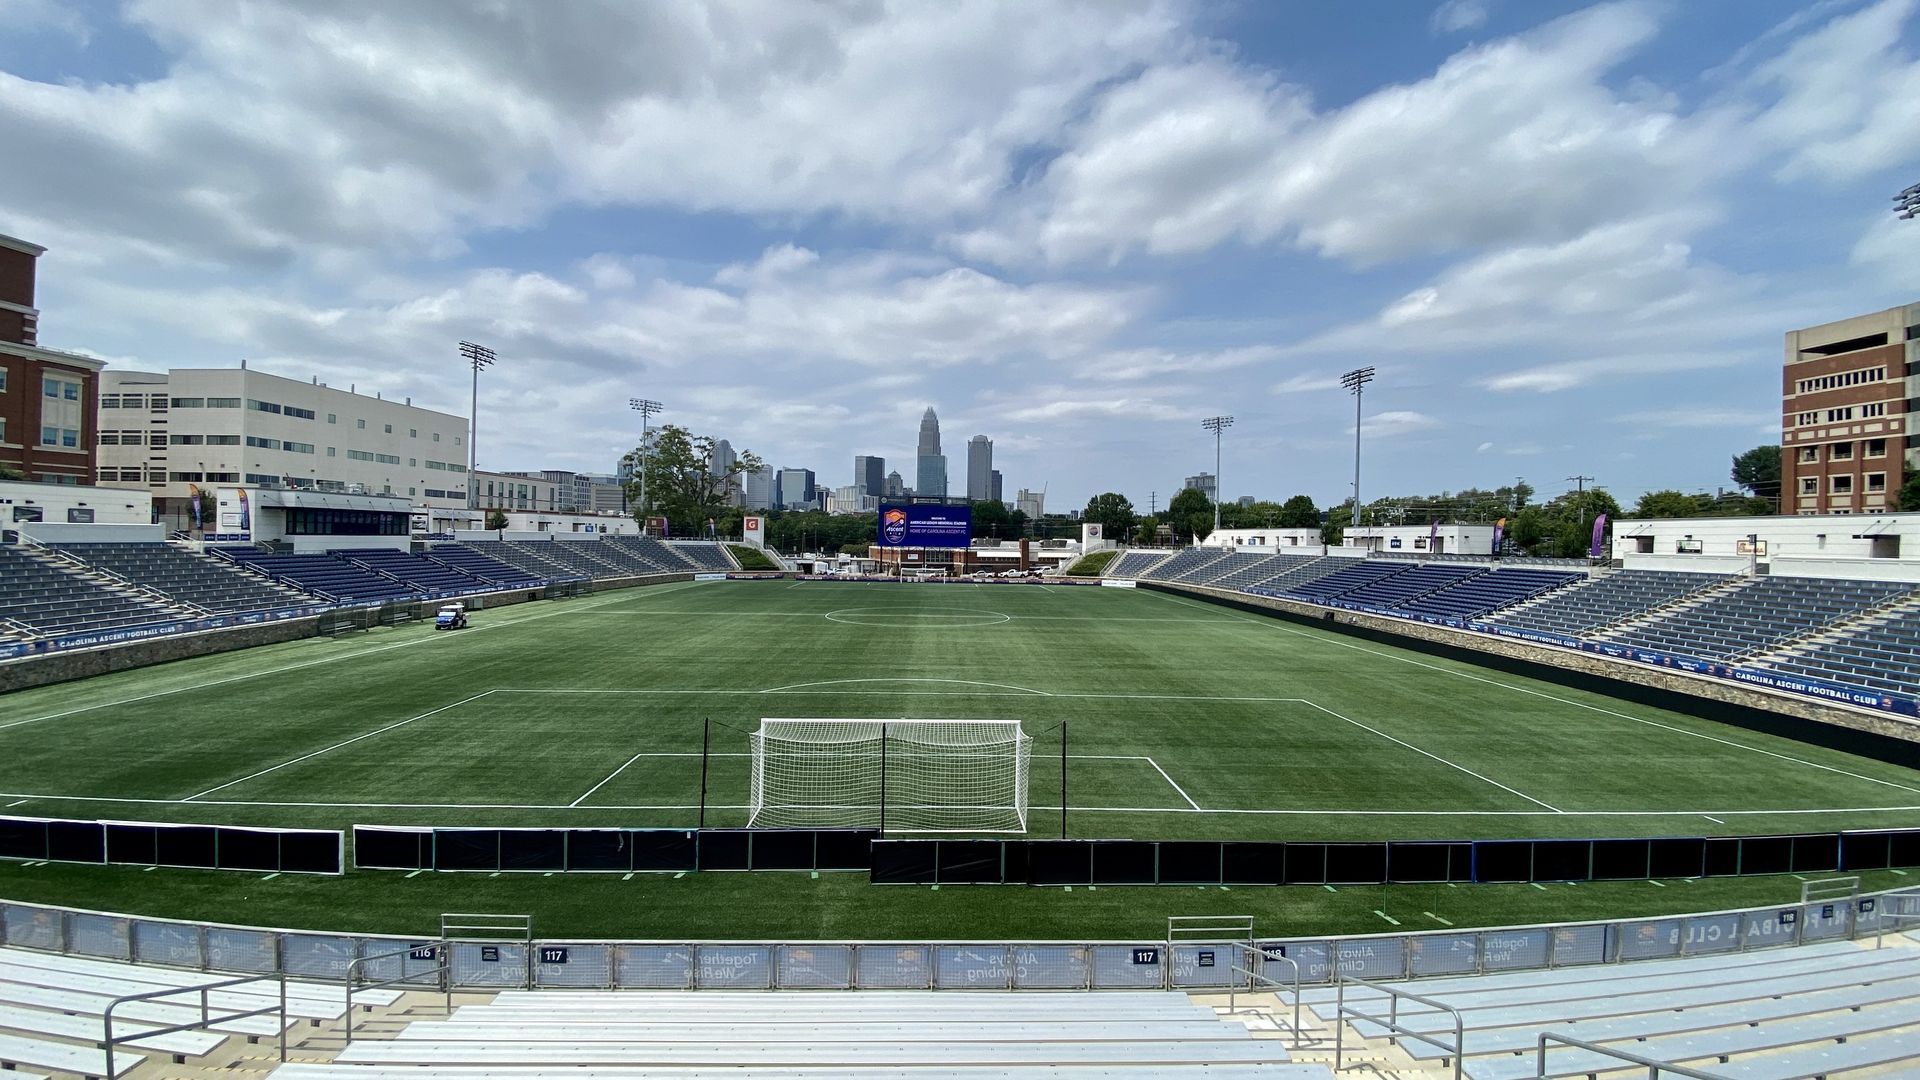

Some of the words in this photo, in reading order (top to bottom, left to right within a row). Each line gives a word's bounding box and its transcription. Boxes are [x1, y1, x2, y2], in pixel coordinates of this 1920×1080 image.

[748, 521, 757, 529] G
[99, 632, 125, 642] ASCENT
[127, 629, 158, 638] FOOTBALL
[160, 626, 176, 634] CLUB
[1735, 672, 1773, 686] CAROLINA
[1776, 679, 1806, 691] ASCENT
[1808, 686, 1851, 701] FOOTBALL
[1853, 694, 1878, 706] CLUB
[1783, 913, 1795, 922] 118
[415, 948, 431, 958] 116
[545, 951, 562, 961] 117
[1137, 952, 1154, 962] 117
